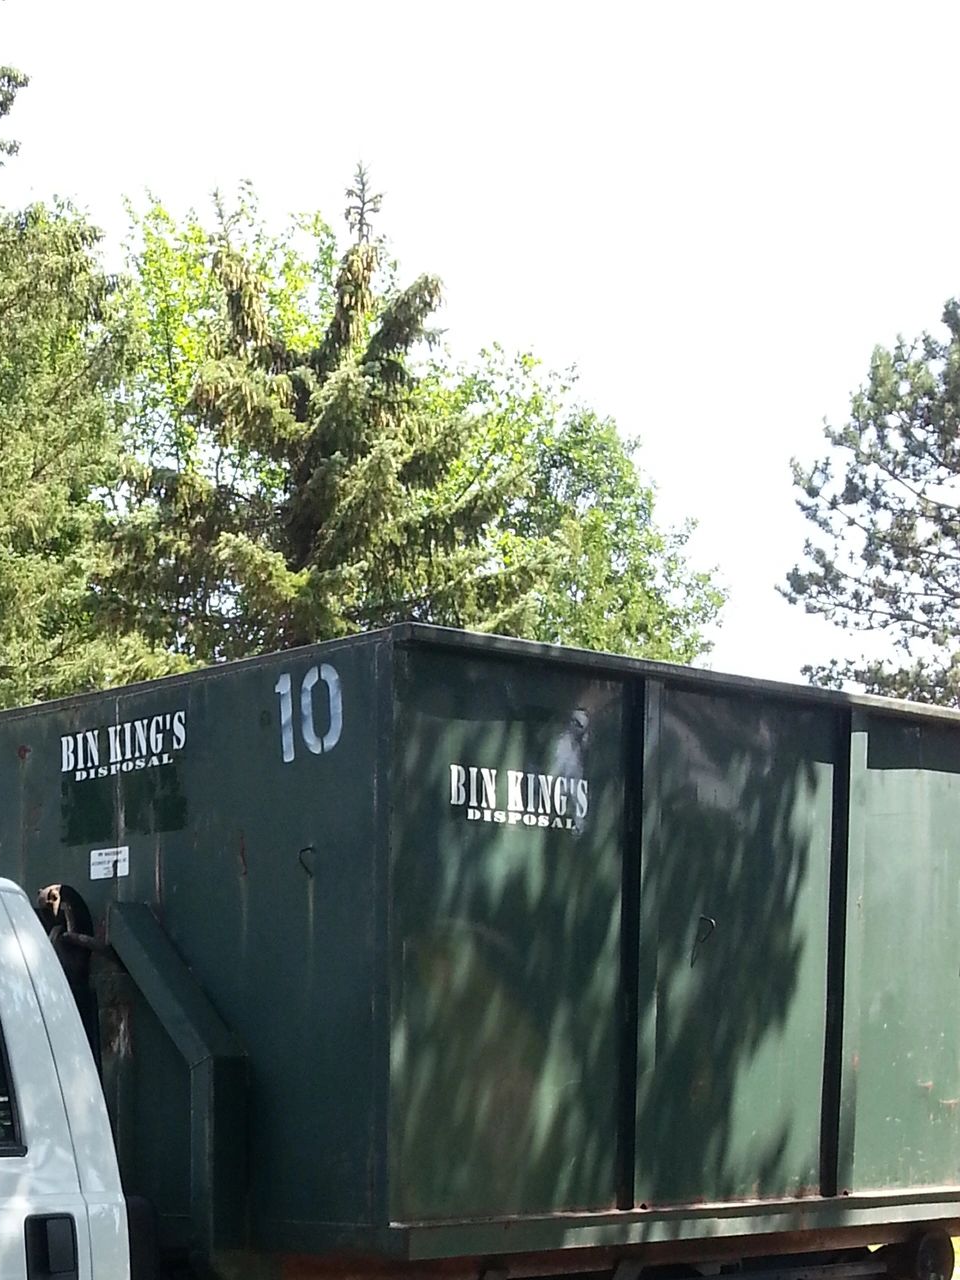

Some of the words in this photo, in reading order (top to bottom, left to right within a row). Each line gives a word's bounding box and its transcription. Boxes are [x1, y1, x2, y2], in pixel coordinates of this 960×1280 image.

[275, 663, 343, 764] 10
[61, 729, 100, 773] BIN
[109, 710, 187, 764] KING'S
[75, 753, 174, 782] DISPOSAL
[449, 764, 497, 809] BIN
[507, 770, 589, 818] KING'S
[467, 808, 577, 830] DISPOSAL
